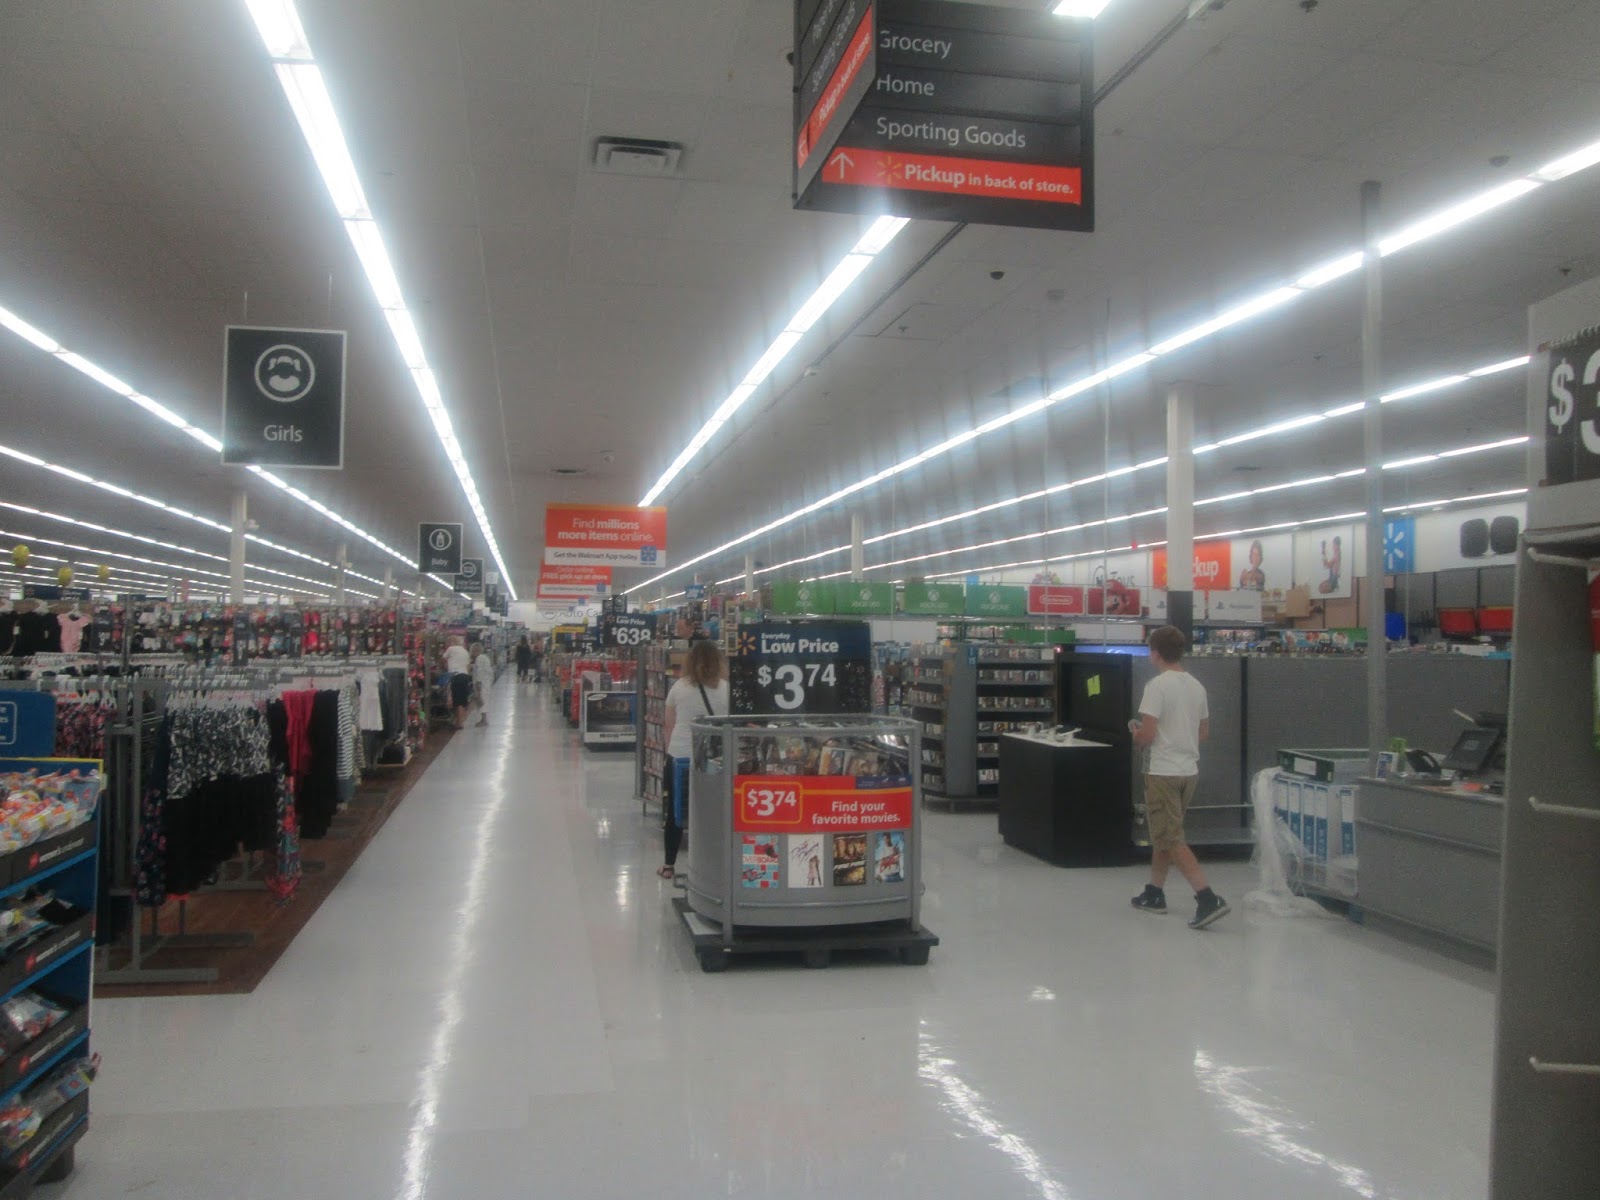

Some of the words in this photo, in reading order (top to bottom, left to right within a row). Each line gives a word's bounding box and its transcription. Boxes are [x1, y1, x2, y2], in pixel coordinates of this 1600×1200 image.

[880, 30, 952, 60] Grocery
[876, 74, 935, 97] Home
[876, 116, 959, 145] Sporting
[965, 125, 1026, 148] Goods
[904, 164, 966, 188] Pickup
[968, 172, 981, 186] in
[984, 173, 1016, 190] back
[1019, 177, 1034, 191] of
[1036, 179, 1074, 194] store.
[263, 424, 304, 442] Girls
[572, 517, 595, 529] Find
[597, 518, 640, 530] millions
[558, 531, 587, 540] more
[588, 530, 618, 541] items
[620, 532, 654, 542] online.
[761, 632, 791, 640] Everyday
[761, 639, 796, 654] Low
[798, 637, 839, 653] Price
[831, 801, 858, 812] Find
[860, 802, 885, 814] your
[812, 814, 858, 825] favorite
[860, 813, 901, 824] movies.
